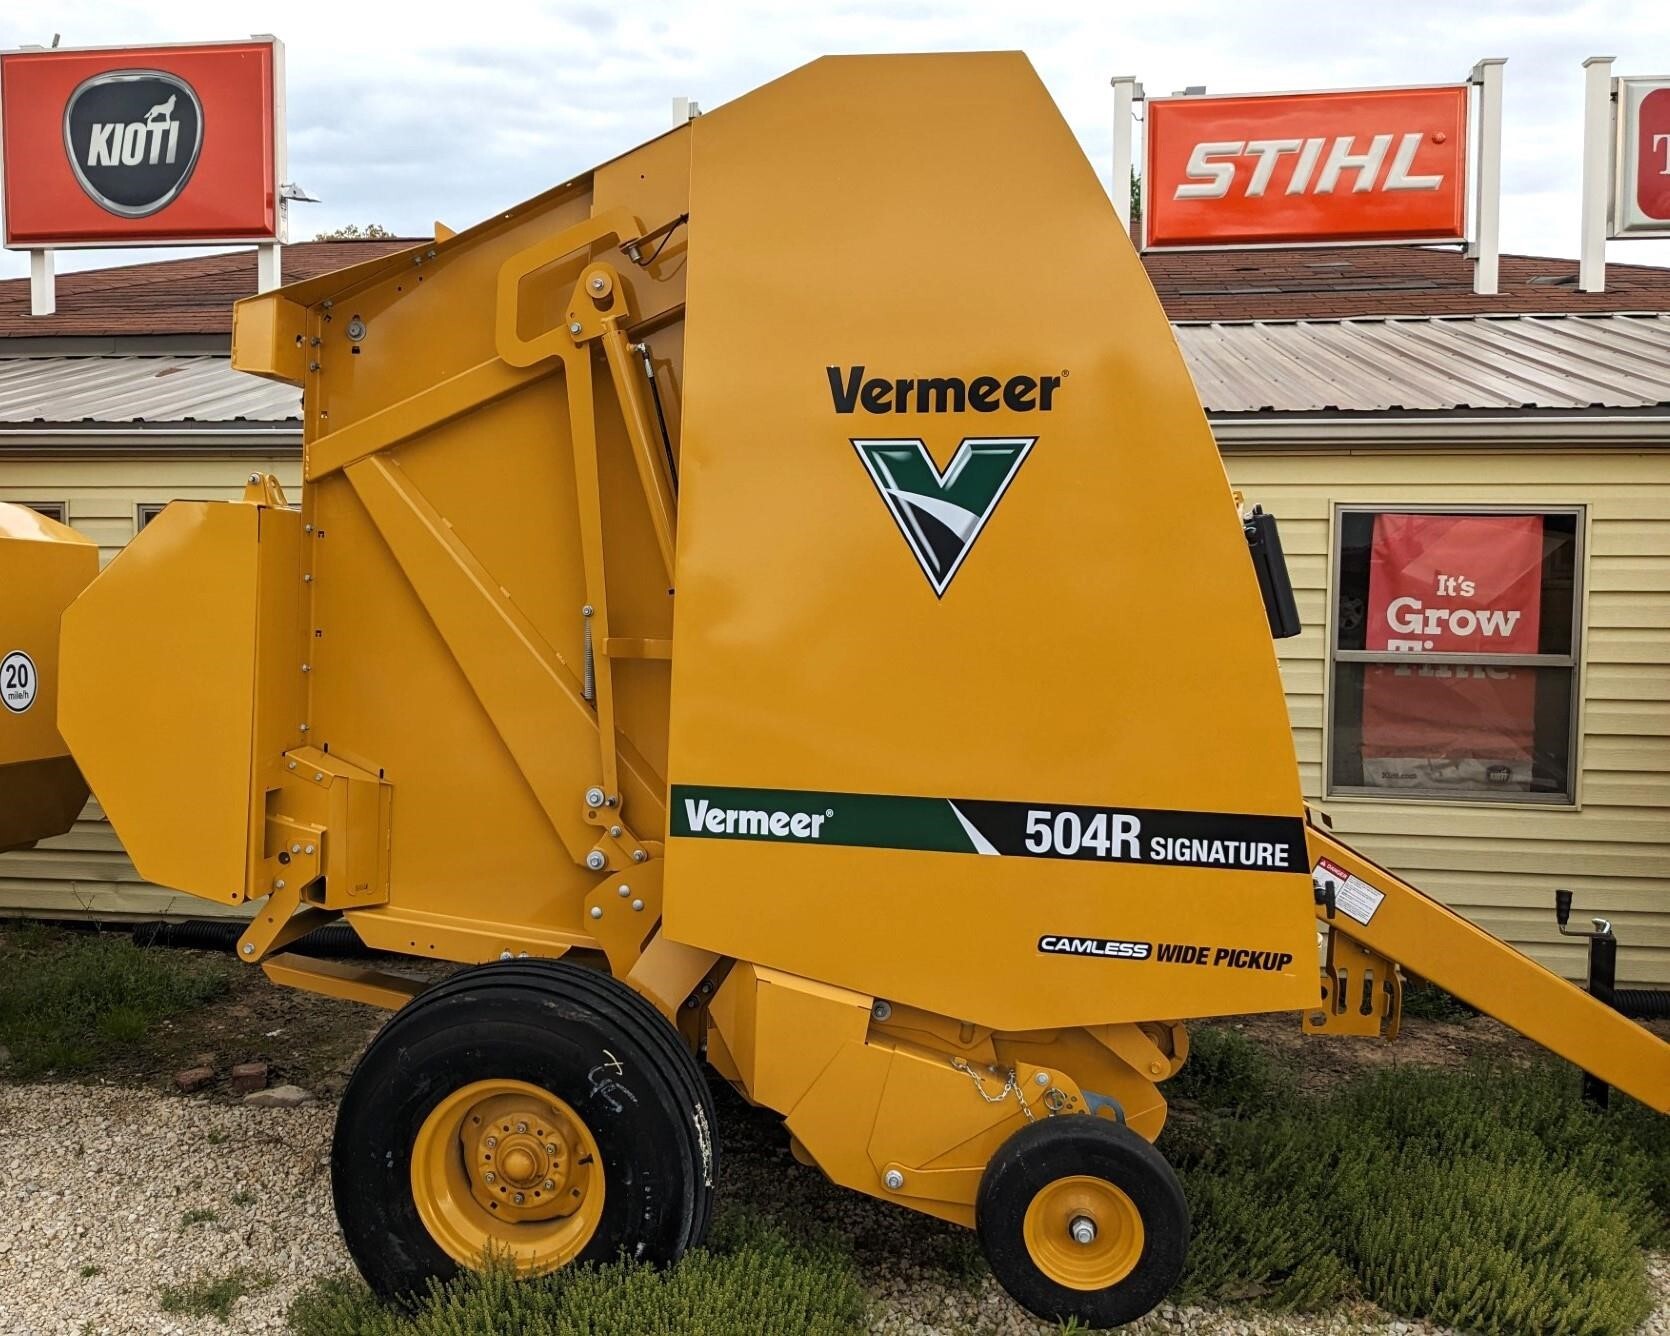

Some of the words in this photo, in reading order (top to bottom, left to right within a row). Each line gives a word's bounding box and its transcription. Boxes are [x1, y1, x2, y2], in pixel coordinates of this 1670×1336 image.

[87, 120, 180, 167] KIOTI
[1173, 132, 1444, 200] STIHL
[1436, 574, 1476, 597] It's
[1386, 596, 1520, 637] Grow
[6, 663, 28, 688] 20
[8, 690, 29, 700] mile/h
[1024, 809, 1142, 859] 504R
[1150, 836, 1289, 867] SIGNATURE
[1326, 863, 1348, 879] DANGER
[1041, 937, 1149, 958] CAMLESS
[1156, 943, 1208, 966] WIDE
[1213, 949, 1293, 972] PICKUP
